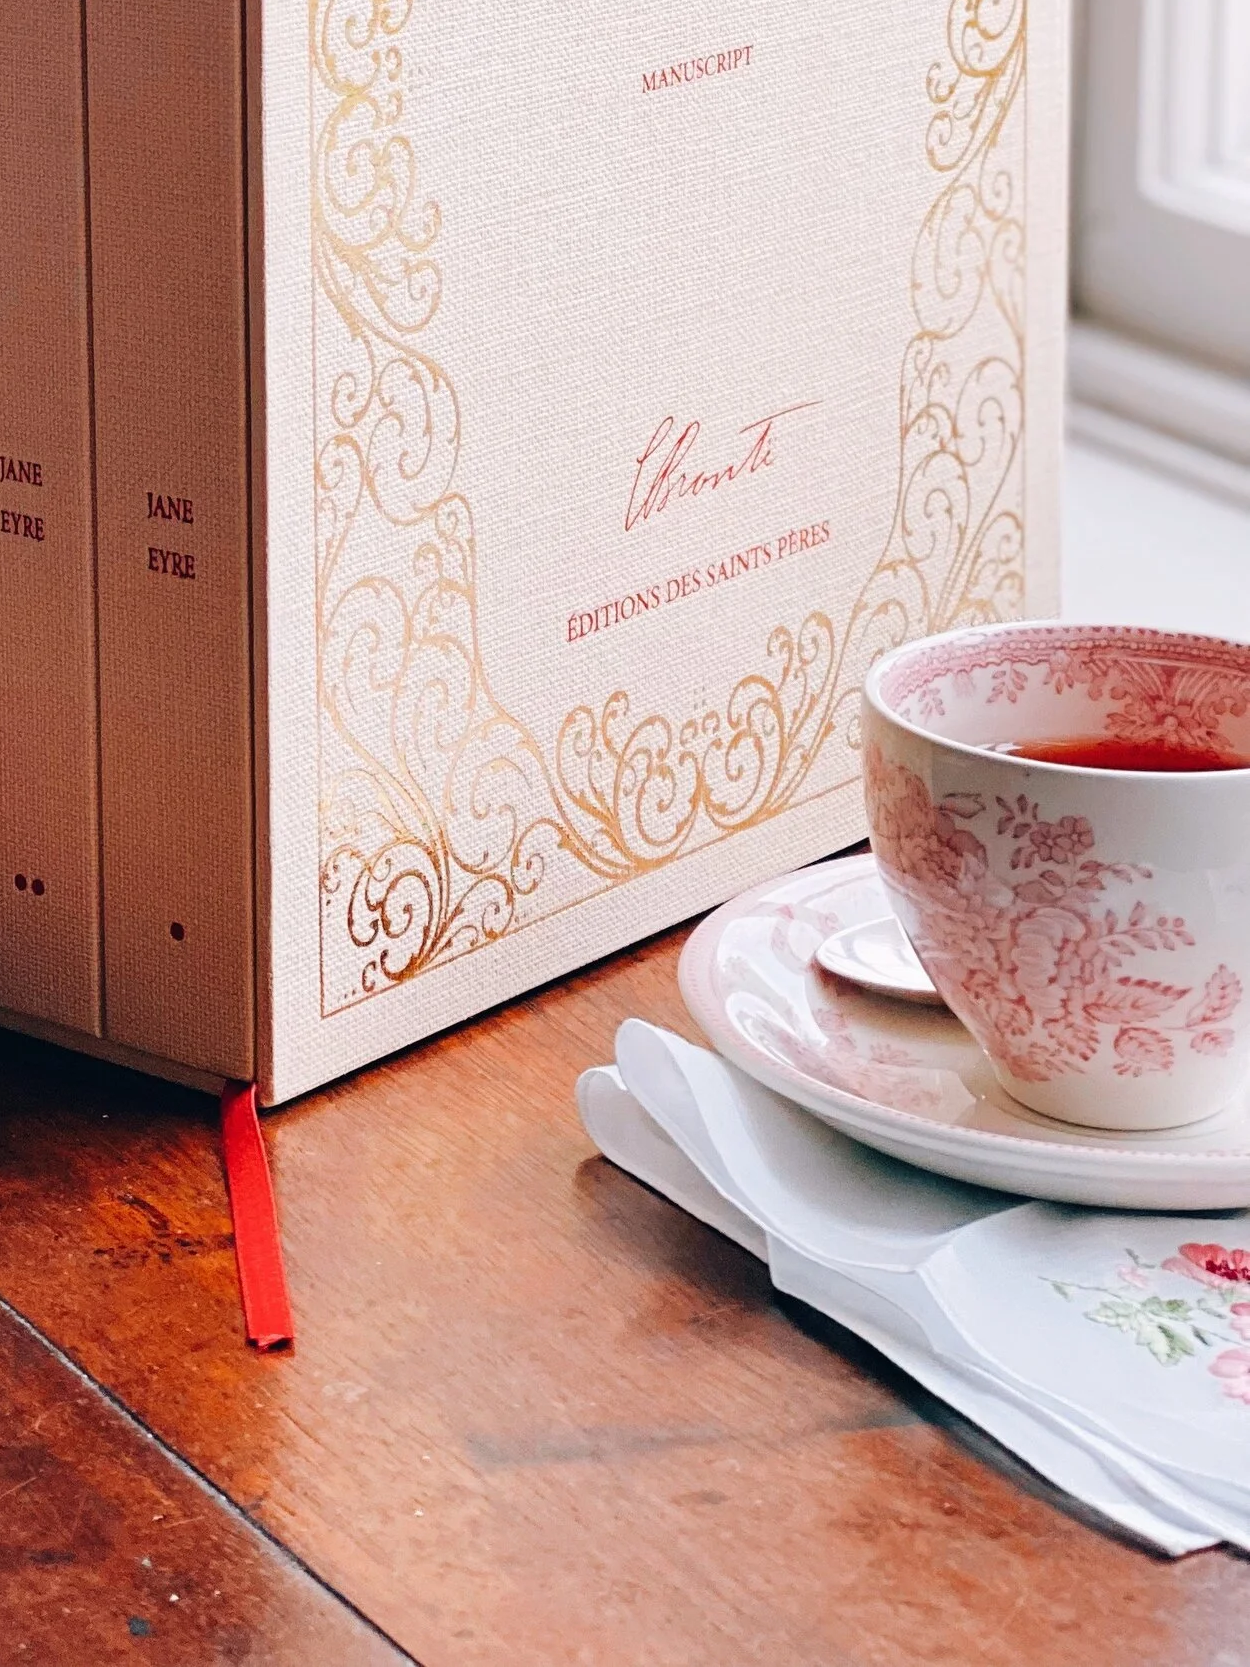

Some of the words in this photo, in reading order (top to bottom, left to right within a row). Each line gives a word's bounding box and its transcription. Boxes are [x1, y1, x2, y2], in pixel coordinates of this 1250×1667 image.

[642, 45, 754, 94] MANUSCRIPT
[0, 456, 43, 487] JANE
[146, 492, 194, 524] JANE
[0, 510, 45, 542] EYRE
[148, 547, 196, 579] EYRE
[566, 585, 660, 643] ÉDITIONS
[665, 570, 701, 603] DES
[706, 541, 772, 587] SAINTS
[777, 520, 831, 560] PÈRES
